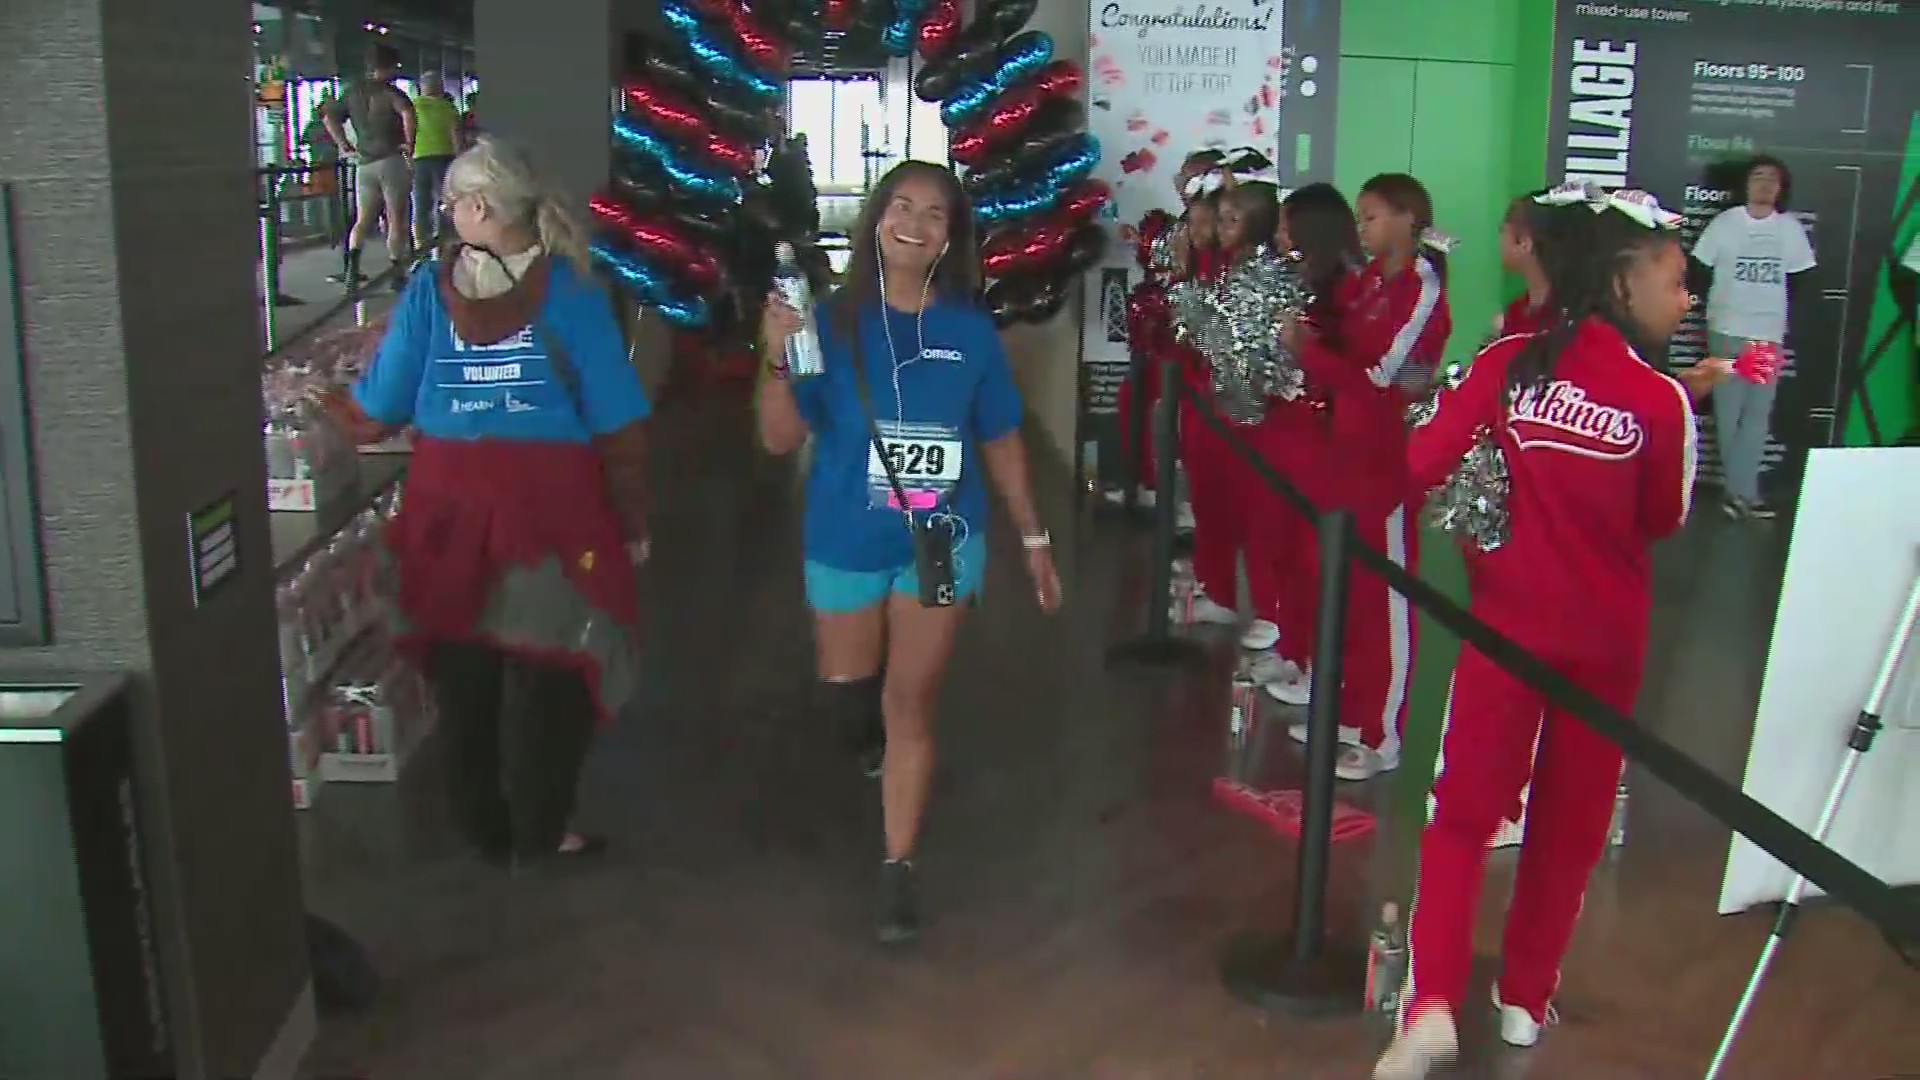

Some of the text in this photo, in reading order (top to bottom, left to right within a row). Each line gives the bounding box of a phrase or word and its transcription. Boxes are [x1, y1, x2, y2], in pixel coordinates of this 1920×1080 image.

[1101, 3, 1273, 38] Congratulations!
[1575, 3, 1649, 19] mixed-use
[1137, 44, 1172, 65] YOU
[1176, 45, 1221, 66] MADE
[1693, 60, 1806, 81] Floors 95-100
[1564, 38, 1638, 188] ILLAGE
[463, 362, 522, 383] VOLUNTEER
[1507, 378, 1637, 446] Vikings
[887, 443, 945, 475] 529
